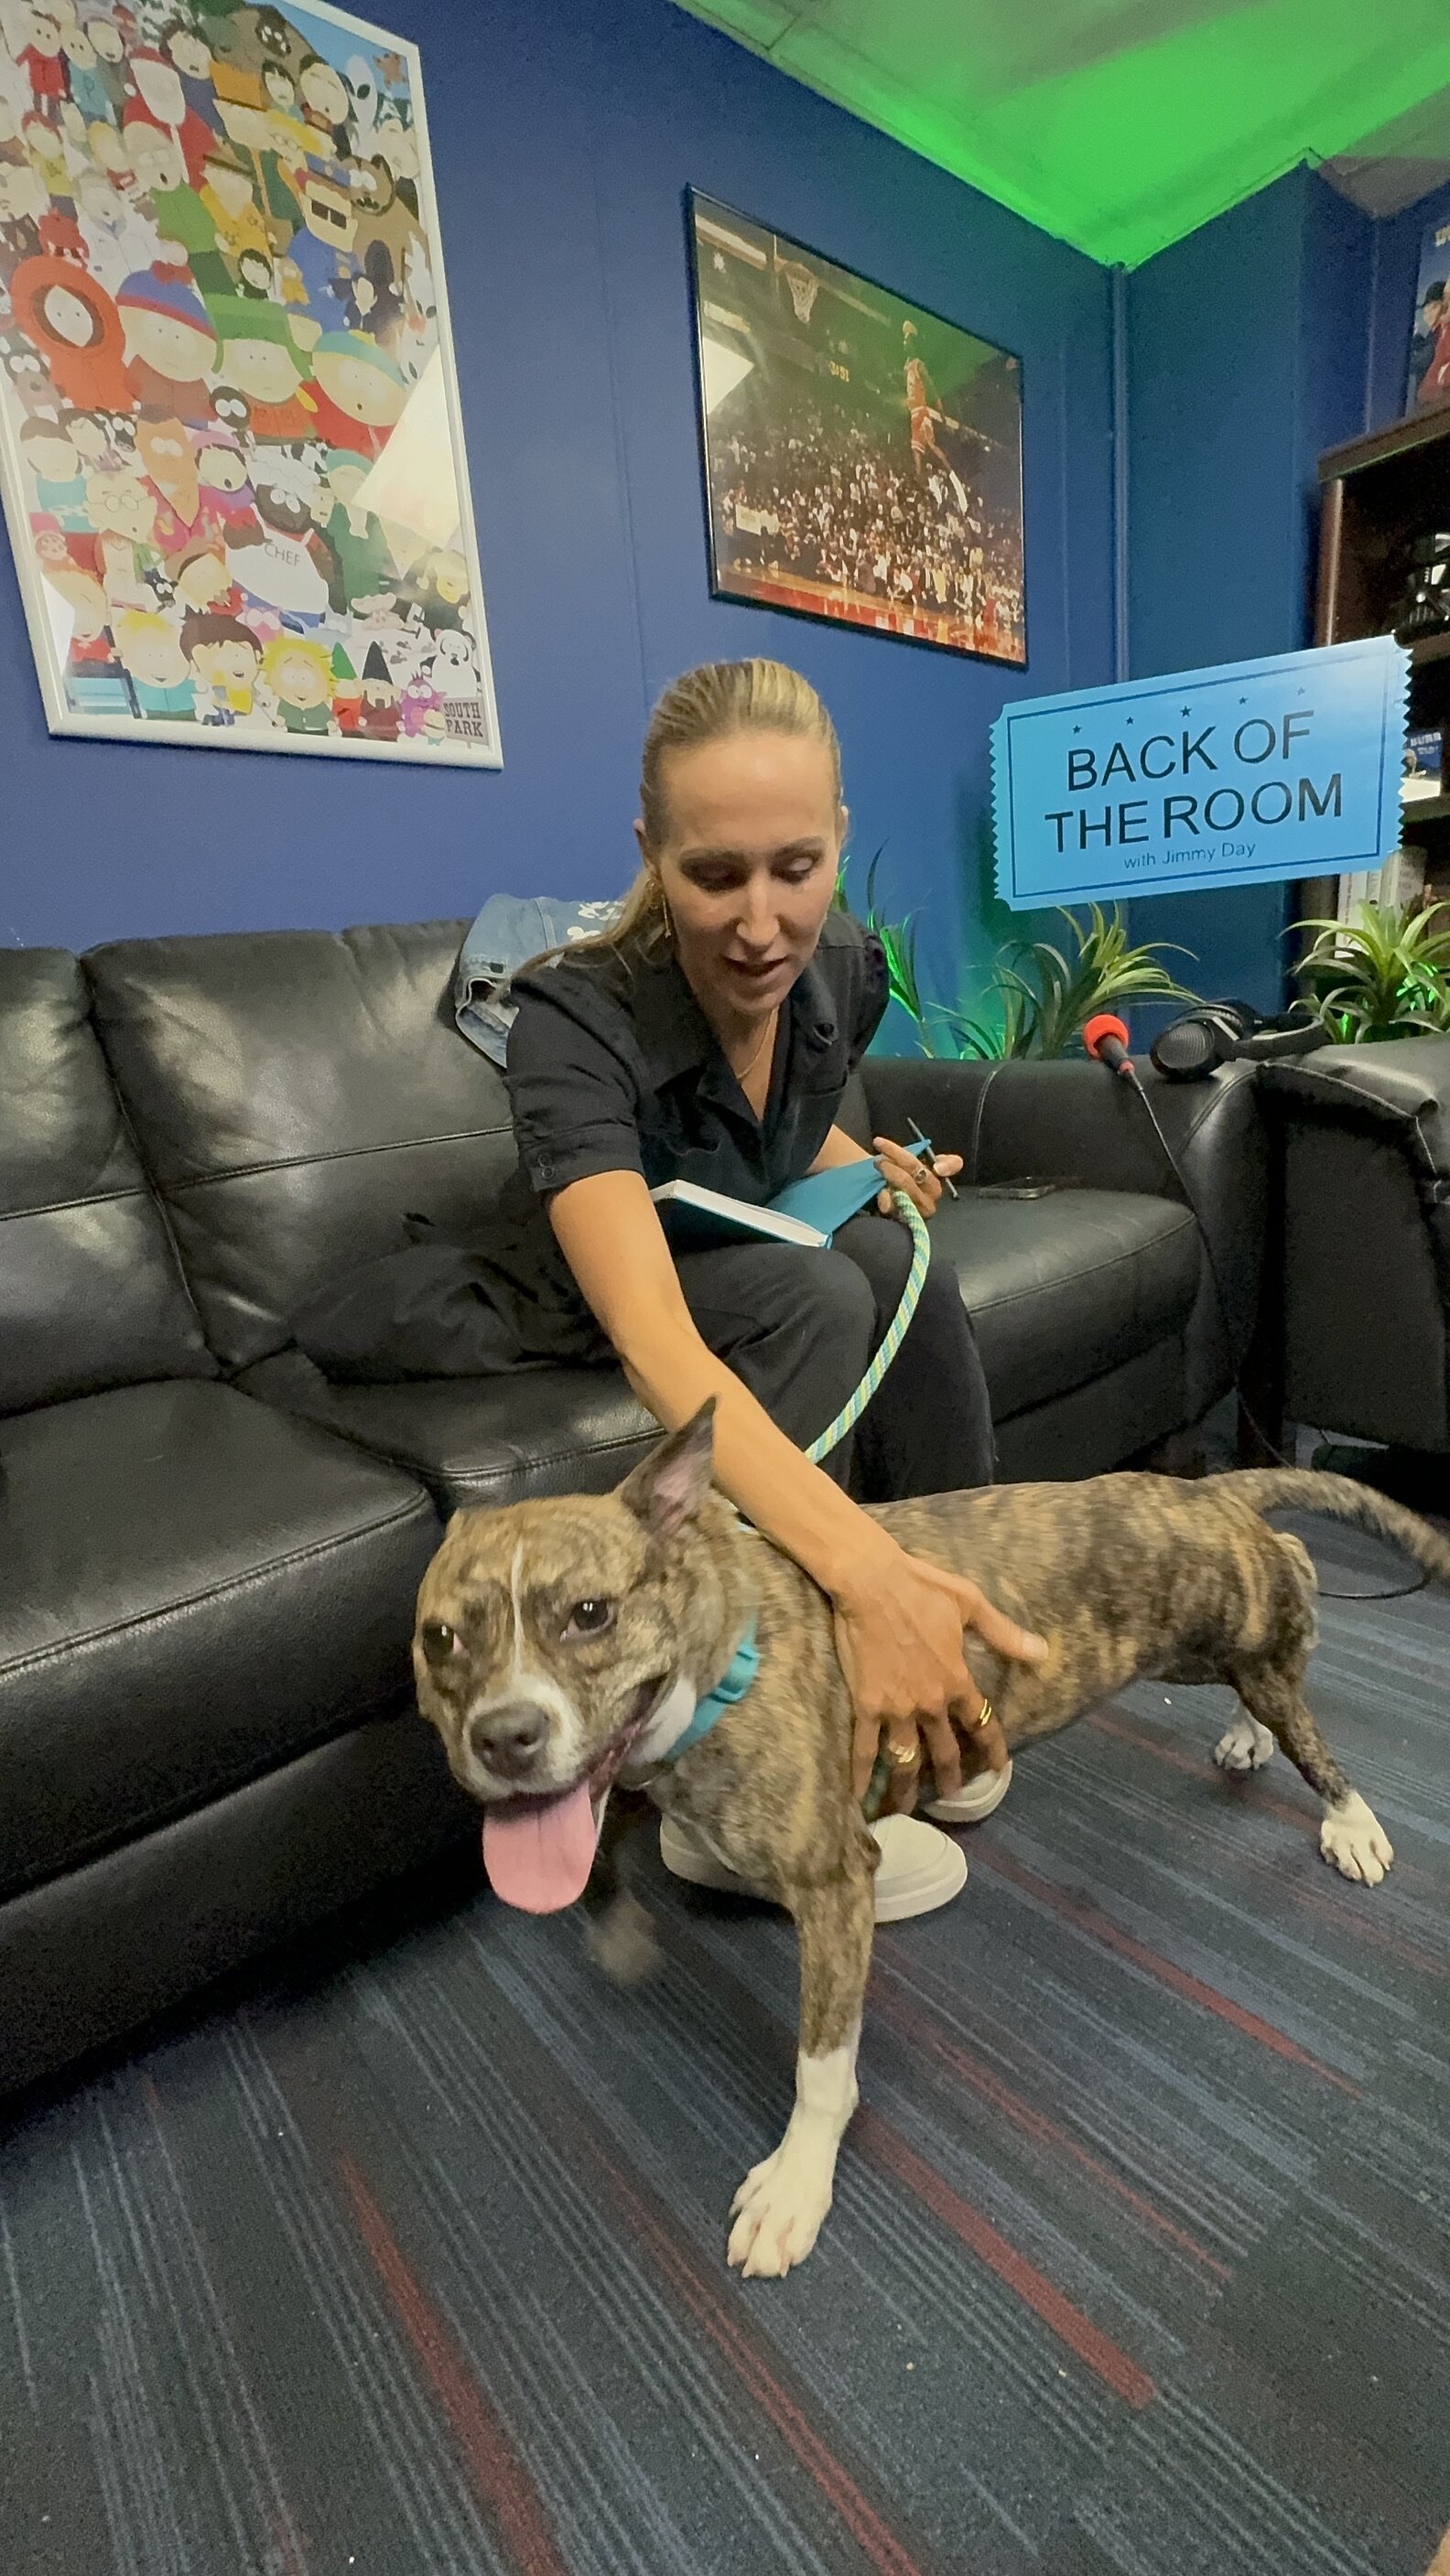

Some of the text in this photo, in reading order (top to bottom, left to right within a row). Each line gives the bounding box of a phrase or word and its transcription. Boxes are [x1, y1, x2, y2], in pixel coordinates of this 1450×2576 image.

[264, 542, 300, 566] CHEF
[443, 702, 482, 719] SOUTH
[445, 719, 483, 738] PARK
[1067, 710, 1314, 792] BACK OF
[1044, 773, 1341, 852] THE ROOM
[1123, 842, 1257, 869] with Jimmy Day
